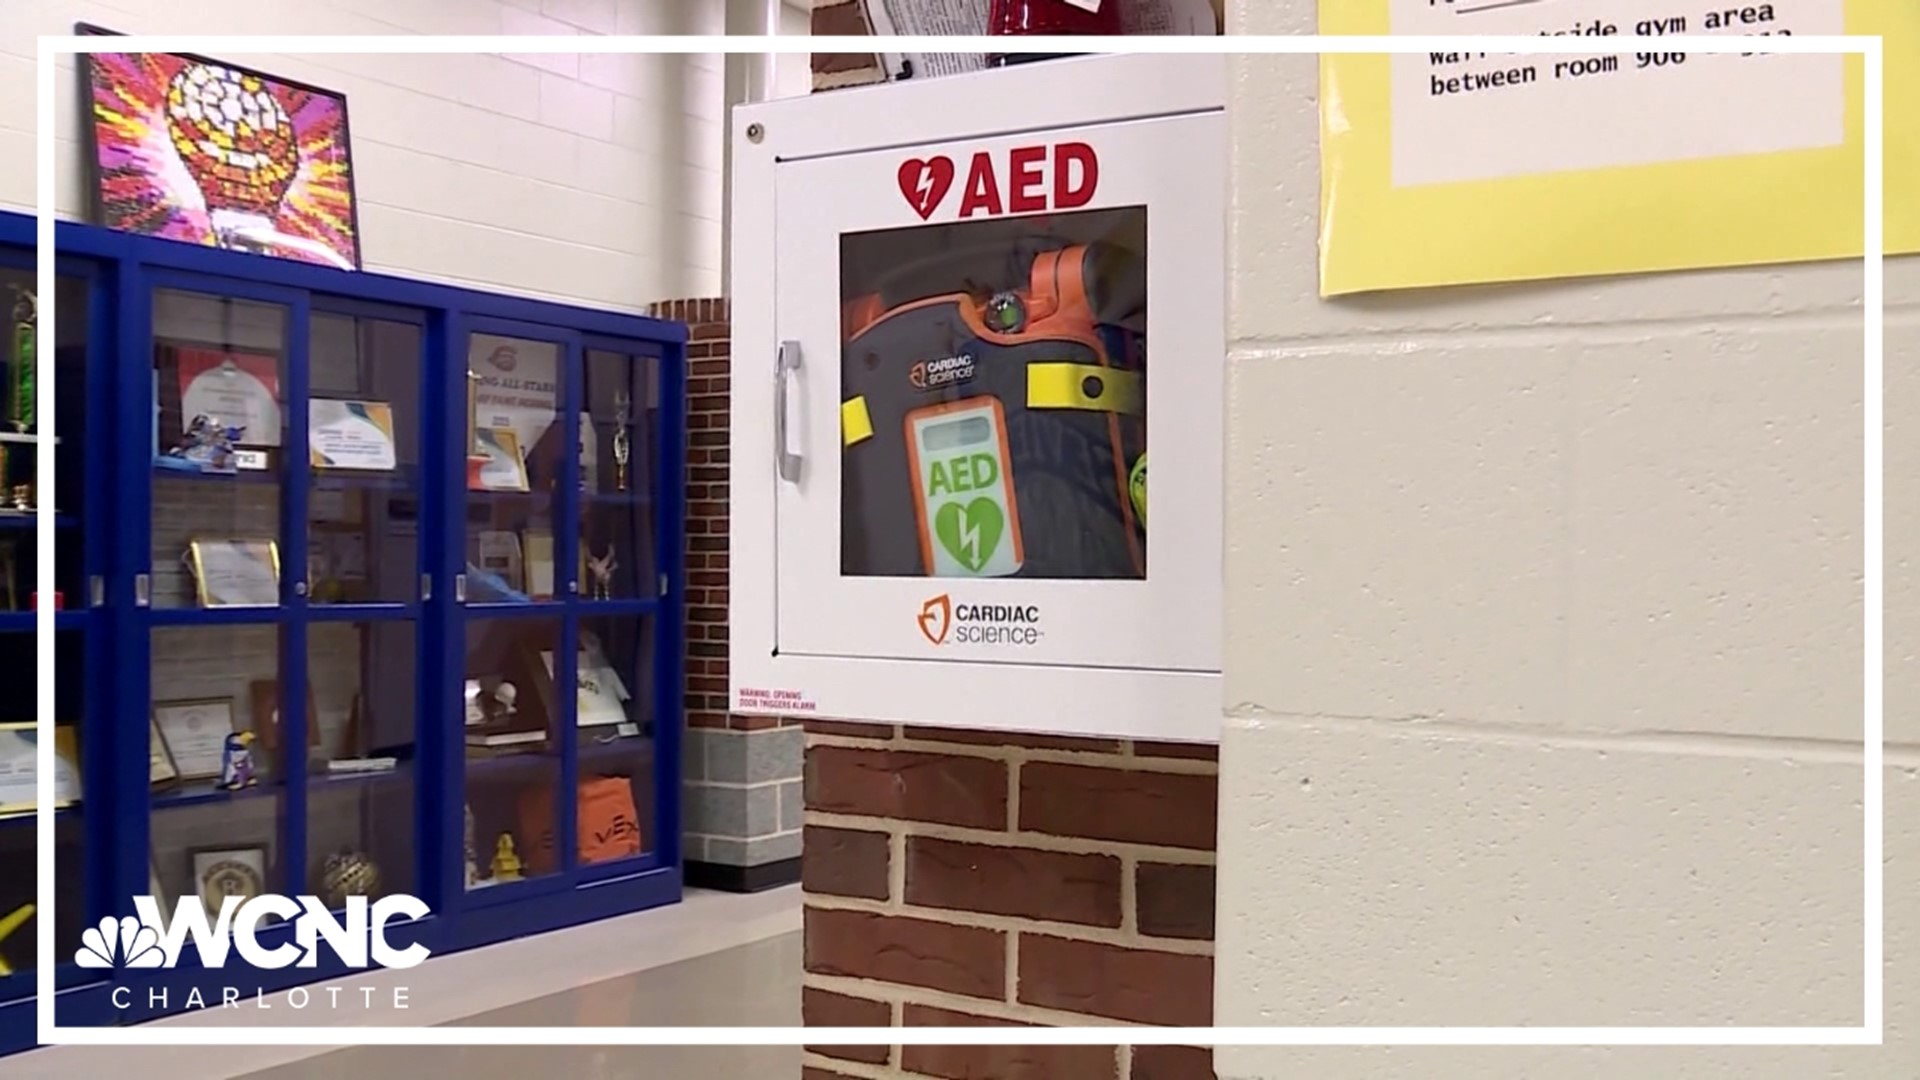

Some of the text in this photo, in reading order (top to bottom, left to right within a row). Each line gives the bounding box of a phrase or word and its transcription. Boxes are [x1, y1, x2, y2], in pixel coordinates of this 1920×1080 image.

[1704, 3, 1775, 29] area
[1430, 65, 1537, 95] between
[1554, 55, 1619, 78] room
[958, 142, 1099, 219] AED
[927, 355, 972, 373] CARDIAC
[928, 453, 999, 497] AED
[956, 604, 1039, 623] CARDIAC
[956, 625, 1038, 645] science
[739, 698, 816, 710] DOOR TRIGGERS ALARM
[773, 690, 802, 700] OPENING
